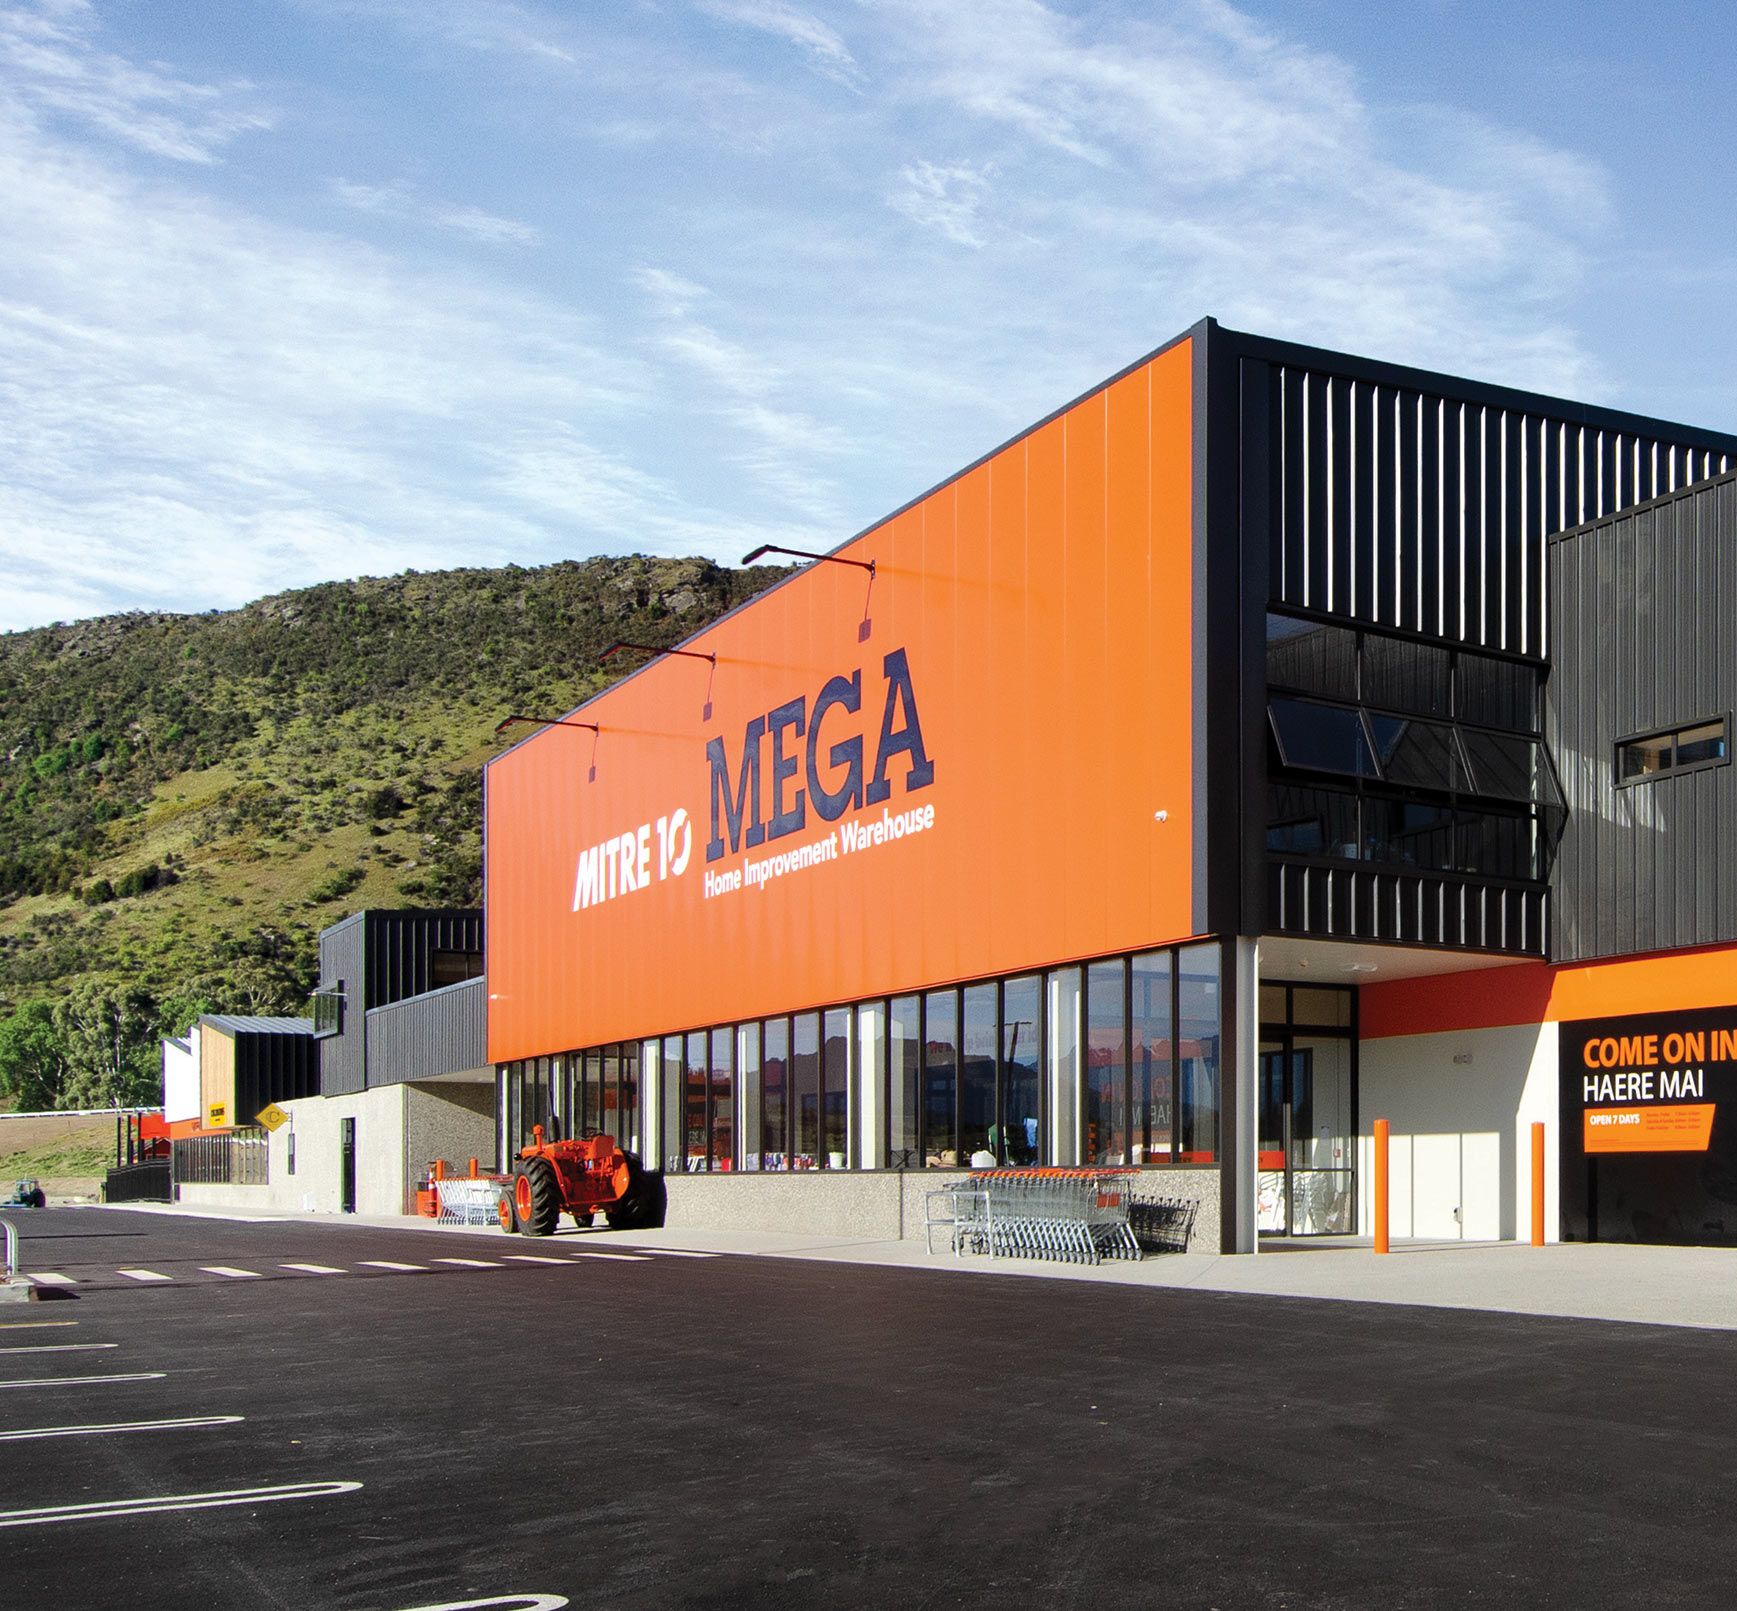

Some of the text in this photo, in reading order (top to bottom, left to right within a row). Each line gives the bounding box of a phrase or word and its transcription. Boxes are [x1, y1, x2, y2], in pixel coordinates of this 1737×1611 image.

[572, 646, 935, 912] MITRE 10 MEGA
[705, 804, 935, 899] Home Improvement Warehouse
[1583, 1034, 1659, 1069] COME
[1662, 1031, 1705, 1065] ON
[1583, 1069, 1704, 1102] HAERE MAI
[1589, 1115, 1612, 1125] OPEN
[1613, 1114, 1618, 1125] 7
[1619, 1113, 1640, 1125] DAYS
